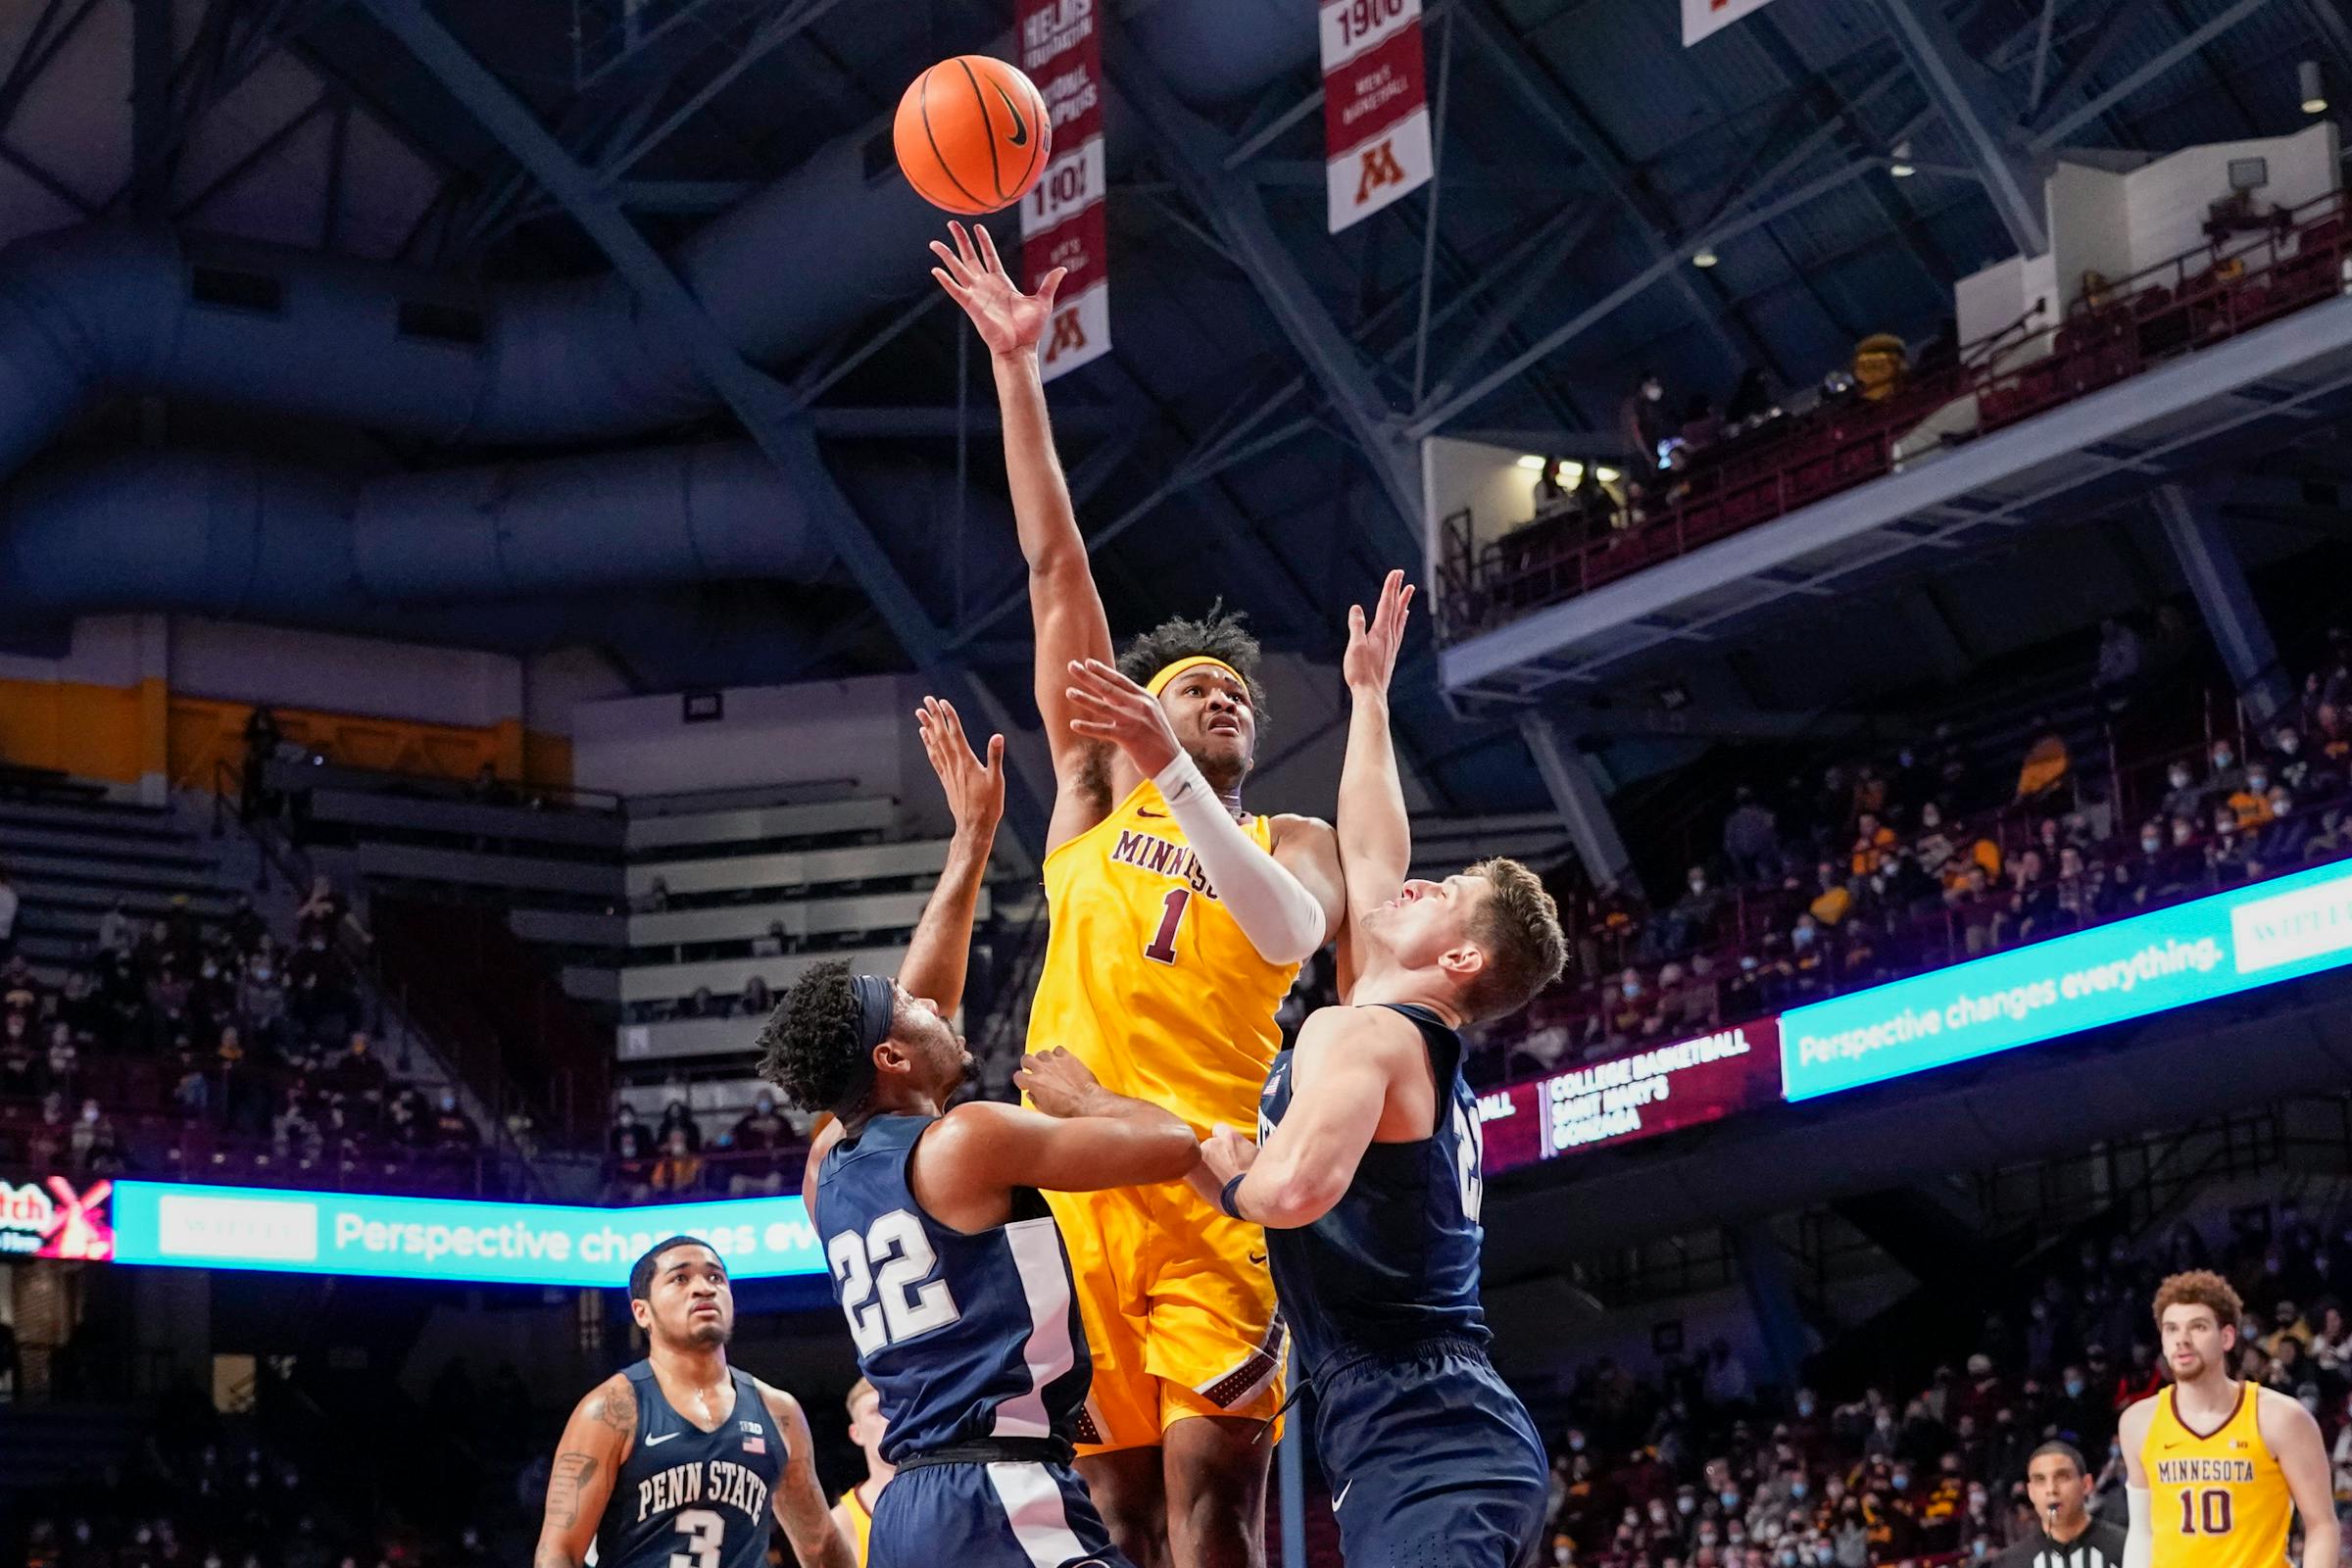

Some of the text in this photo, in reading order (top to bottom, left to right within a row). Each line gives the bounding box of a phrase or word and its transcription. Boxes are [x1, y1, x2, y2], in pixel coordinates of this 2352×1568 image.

[1143, 886, 1193, 966] 1
[1798, 1007, 1941, 1067] Perspective
[1945, 976, 2057, 1020] changes
[1550, 1028, 1751, 1102] COLLEGE BASKETBALL
[335, 1211, 572, 1263] Perspective
[828, 1207, 961, 1358] 22
[637, 1461, 704, 1523] PENN
[708, 1460, 768, 1528] STATE
[2157, 1457, 2254, 1484] MINNESOTA
[668, 1507, 726, 1568] 3
[2179, 1488, 2233, 1537] 10
